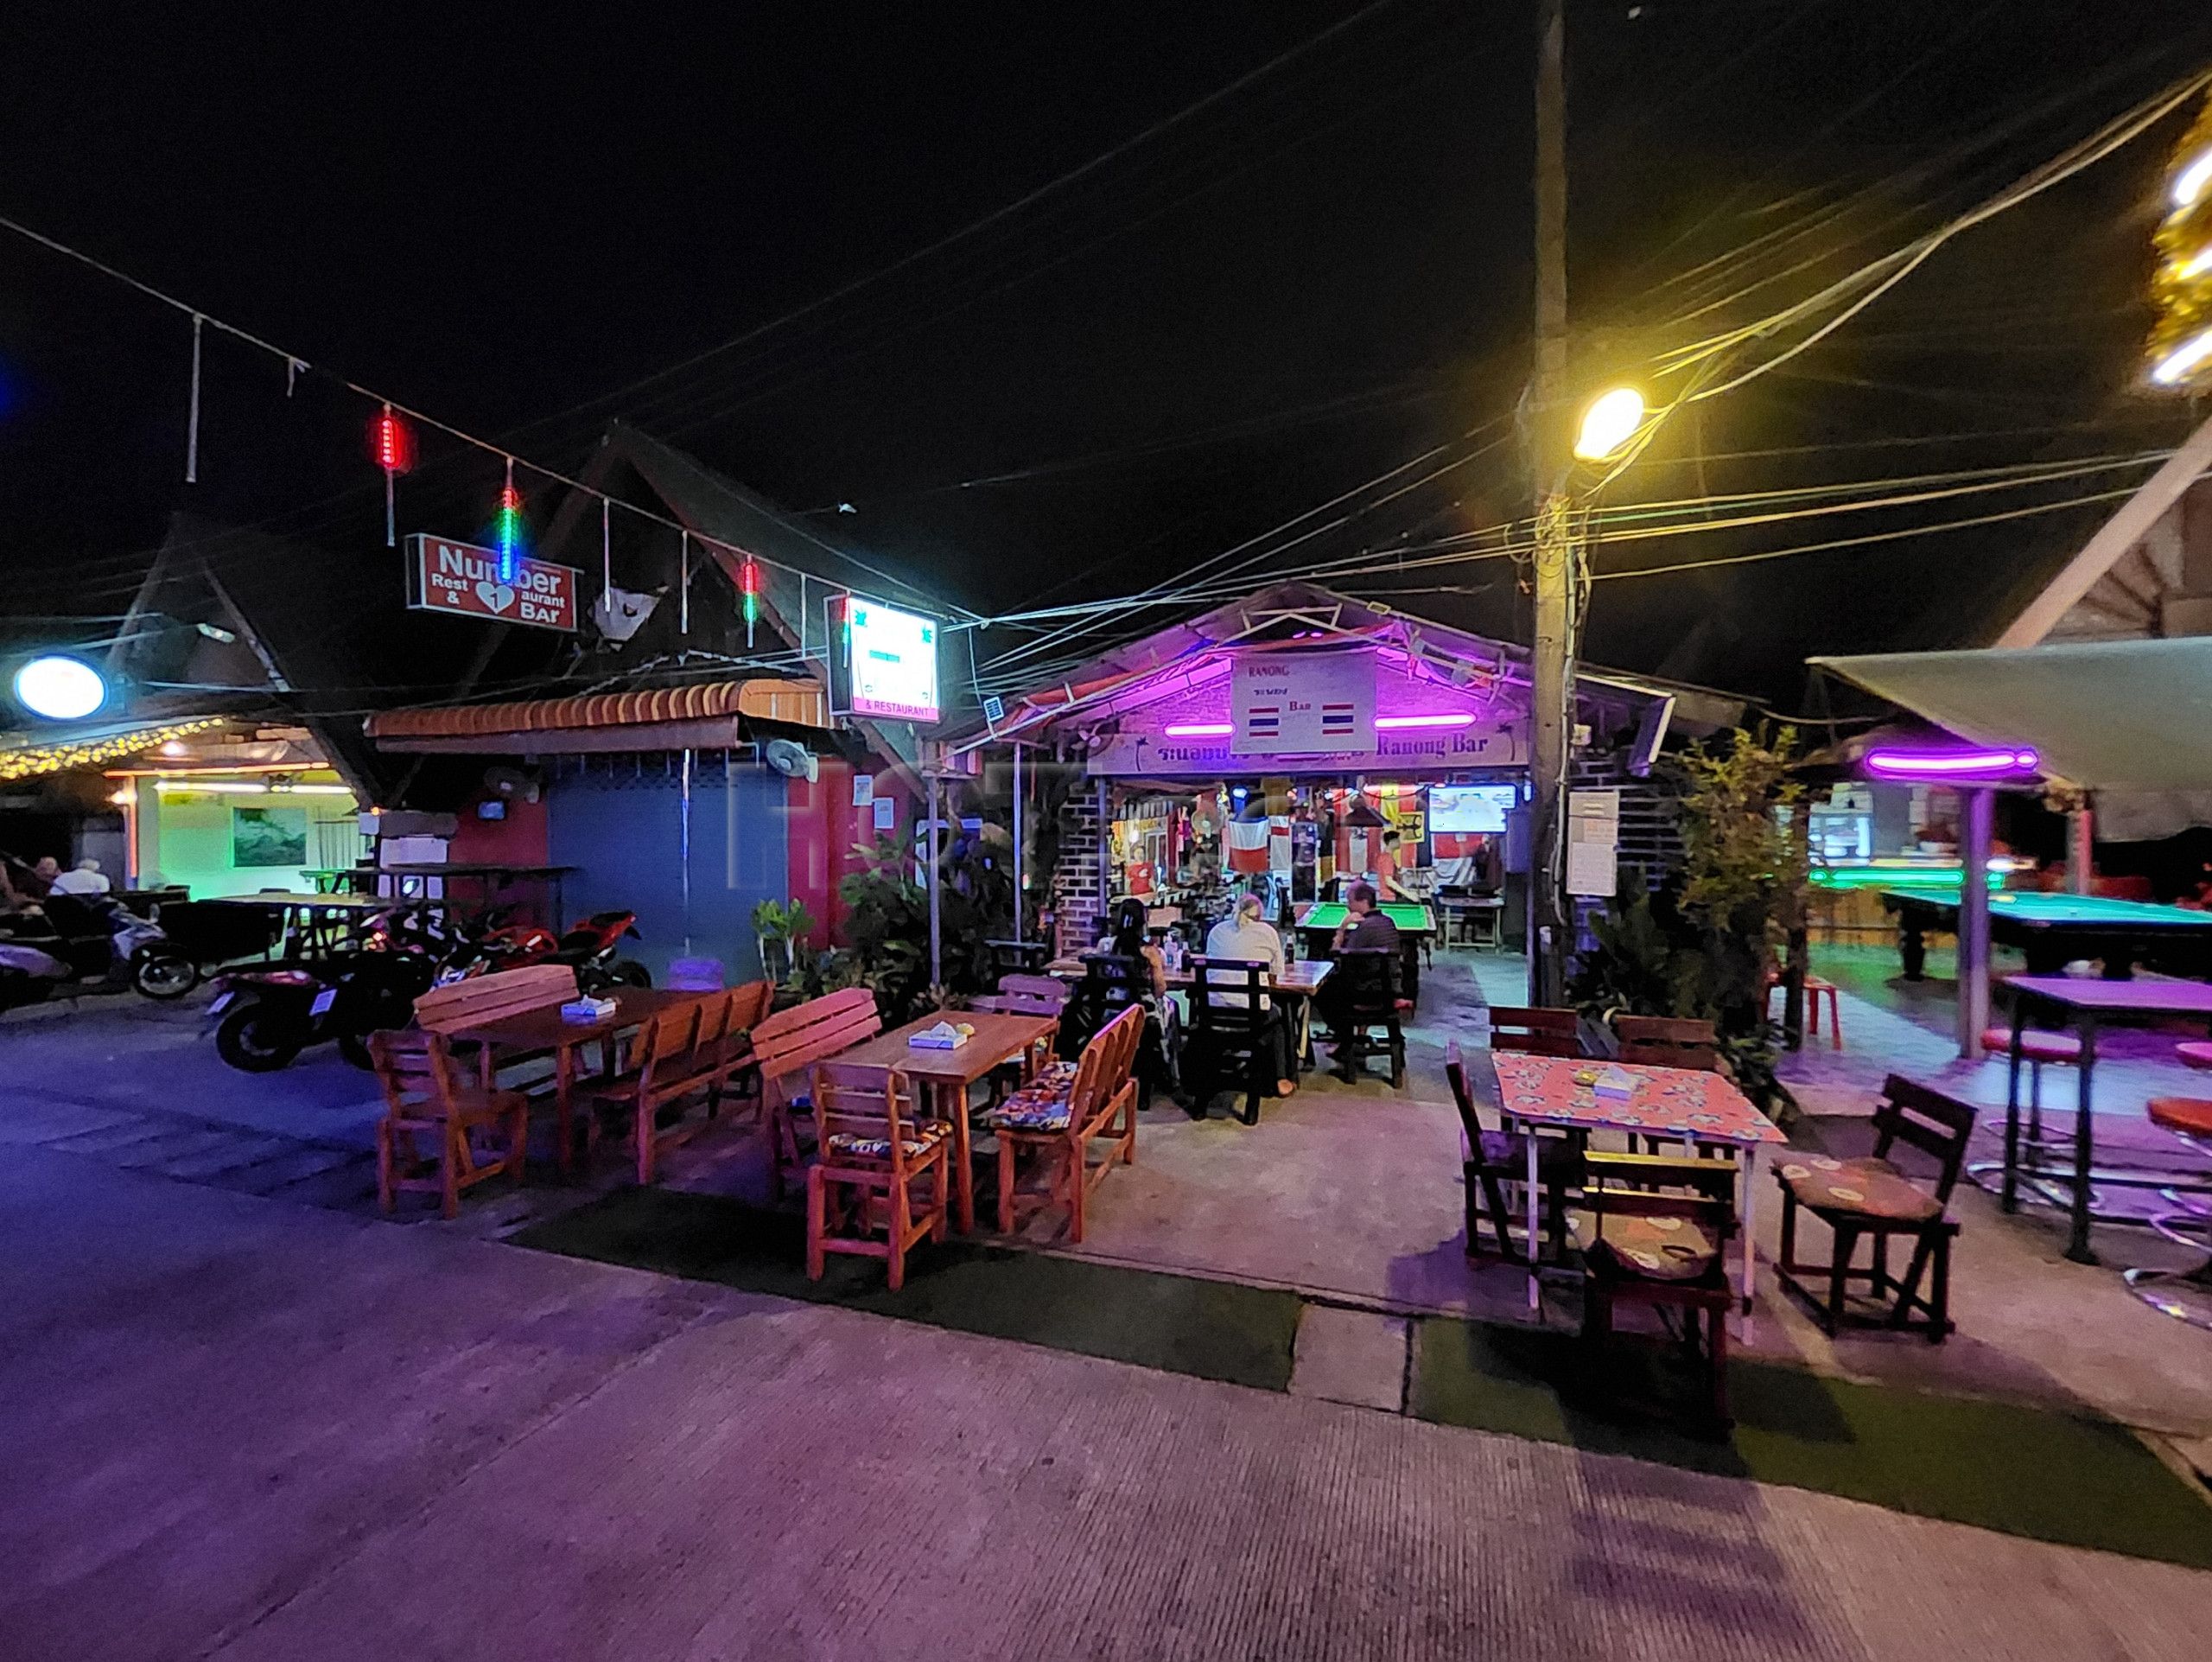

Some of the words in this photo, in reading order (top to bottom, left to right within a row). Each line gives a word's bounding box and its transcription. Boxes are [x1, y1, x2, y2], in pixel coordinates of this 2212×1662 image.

[433, 573, 468, 591] Rest
[522, 590, 565, 608] aurant
[448, 591, 460, 605] &
[491, 593, 499, 609] 1
[874, 701, 929, 716] RESTAURANT
[1376, 735, 1446, 758] Ranong
[1452, 733, 1489, 753] Bar
